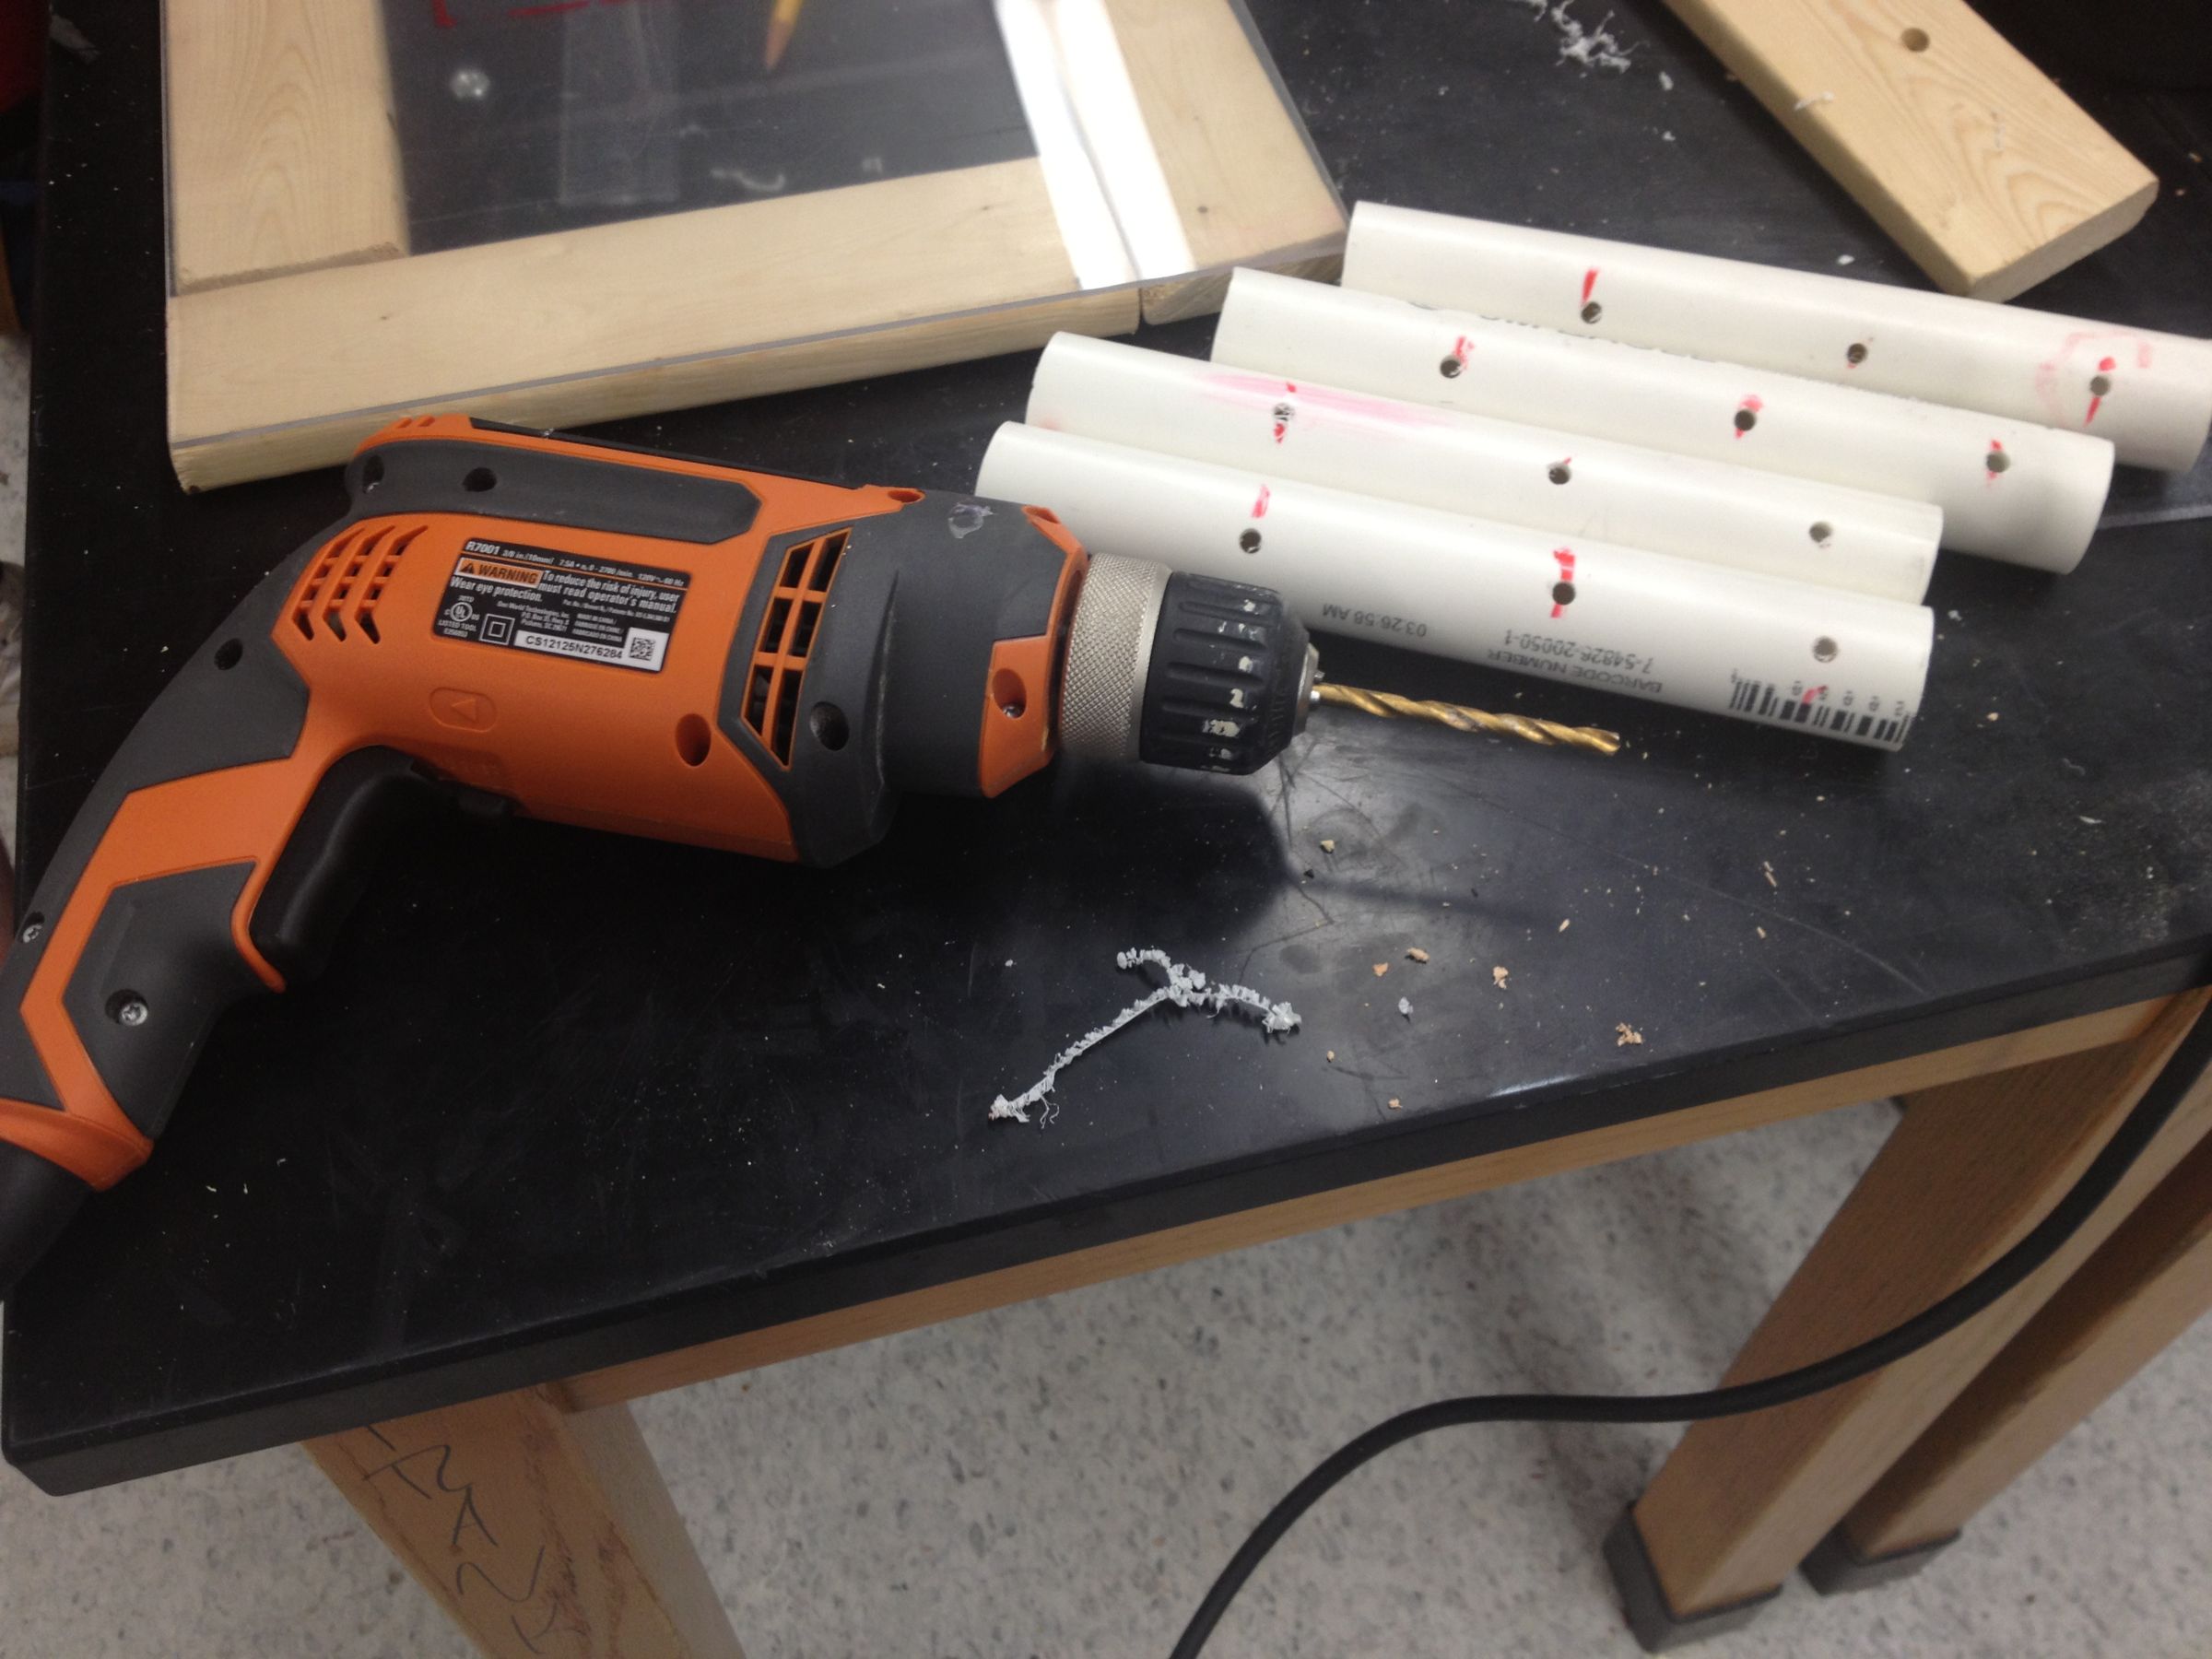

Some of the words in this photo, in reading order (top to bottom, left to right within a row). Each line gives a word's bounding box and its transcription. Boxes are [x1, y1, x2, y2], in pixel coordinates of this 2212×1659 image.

[465, 541, 500, 555] R7001
[449, 576, 476, 591] Wear
[475, 584, 494, 595] eye
[492, 587, 543, 602] protection.
[478, 563, 539, 584] WARNING
[542, 570, 555, 582] To
[554, 573, 587, 587] reduce
[586, 577, 602, 590] the
[601, 580, 619, 593] risk
[619, 583, 631, 594] of
[629, 584, 657, 600] injury,
[658, 592, 680, 603] user
[537, 582, 562, 594] must
[562, 587, 587, 598] read
[587, 591, 638, 607] operator's
[638, 599, 677, 615] manual.
[1322, 604, 1352, 620] AM
[525, 635, 623, 659] CS12125N276284
[1487, 649, 1567, 674] NUMBER
[1572, 665, 1664, 693] BARCODE
